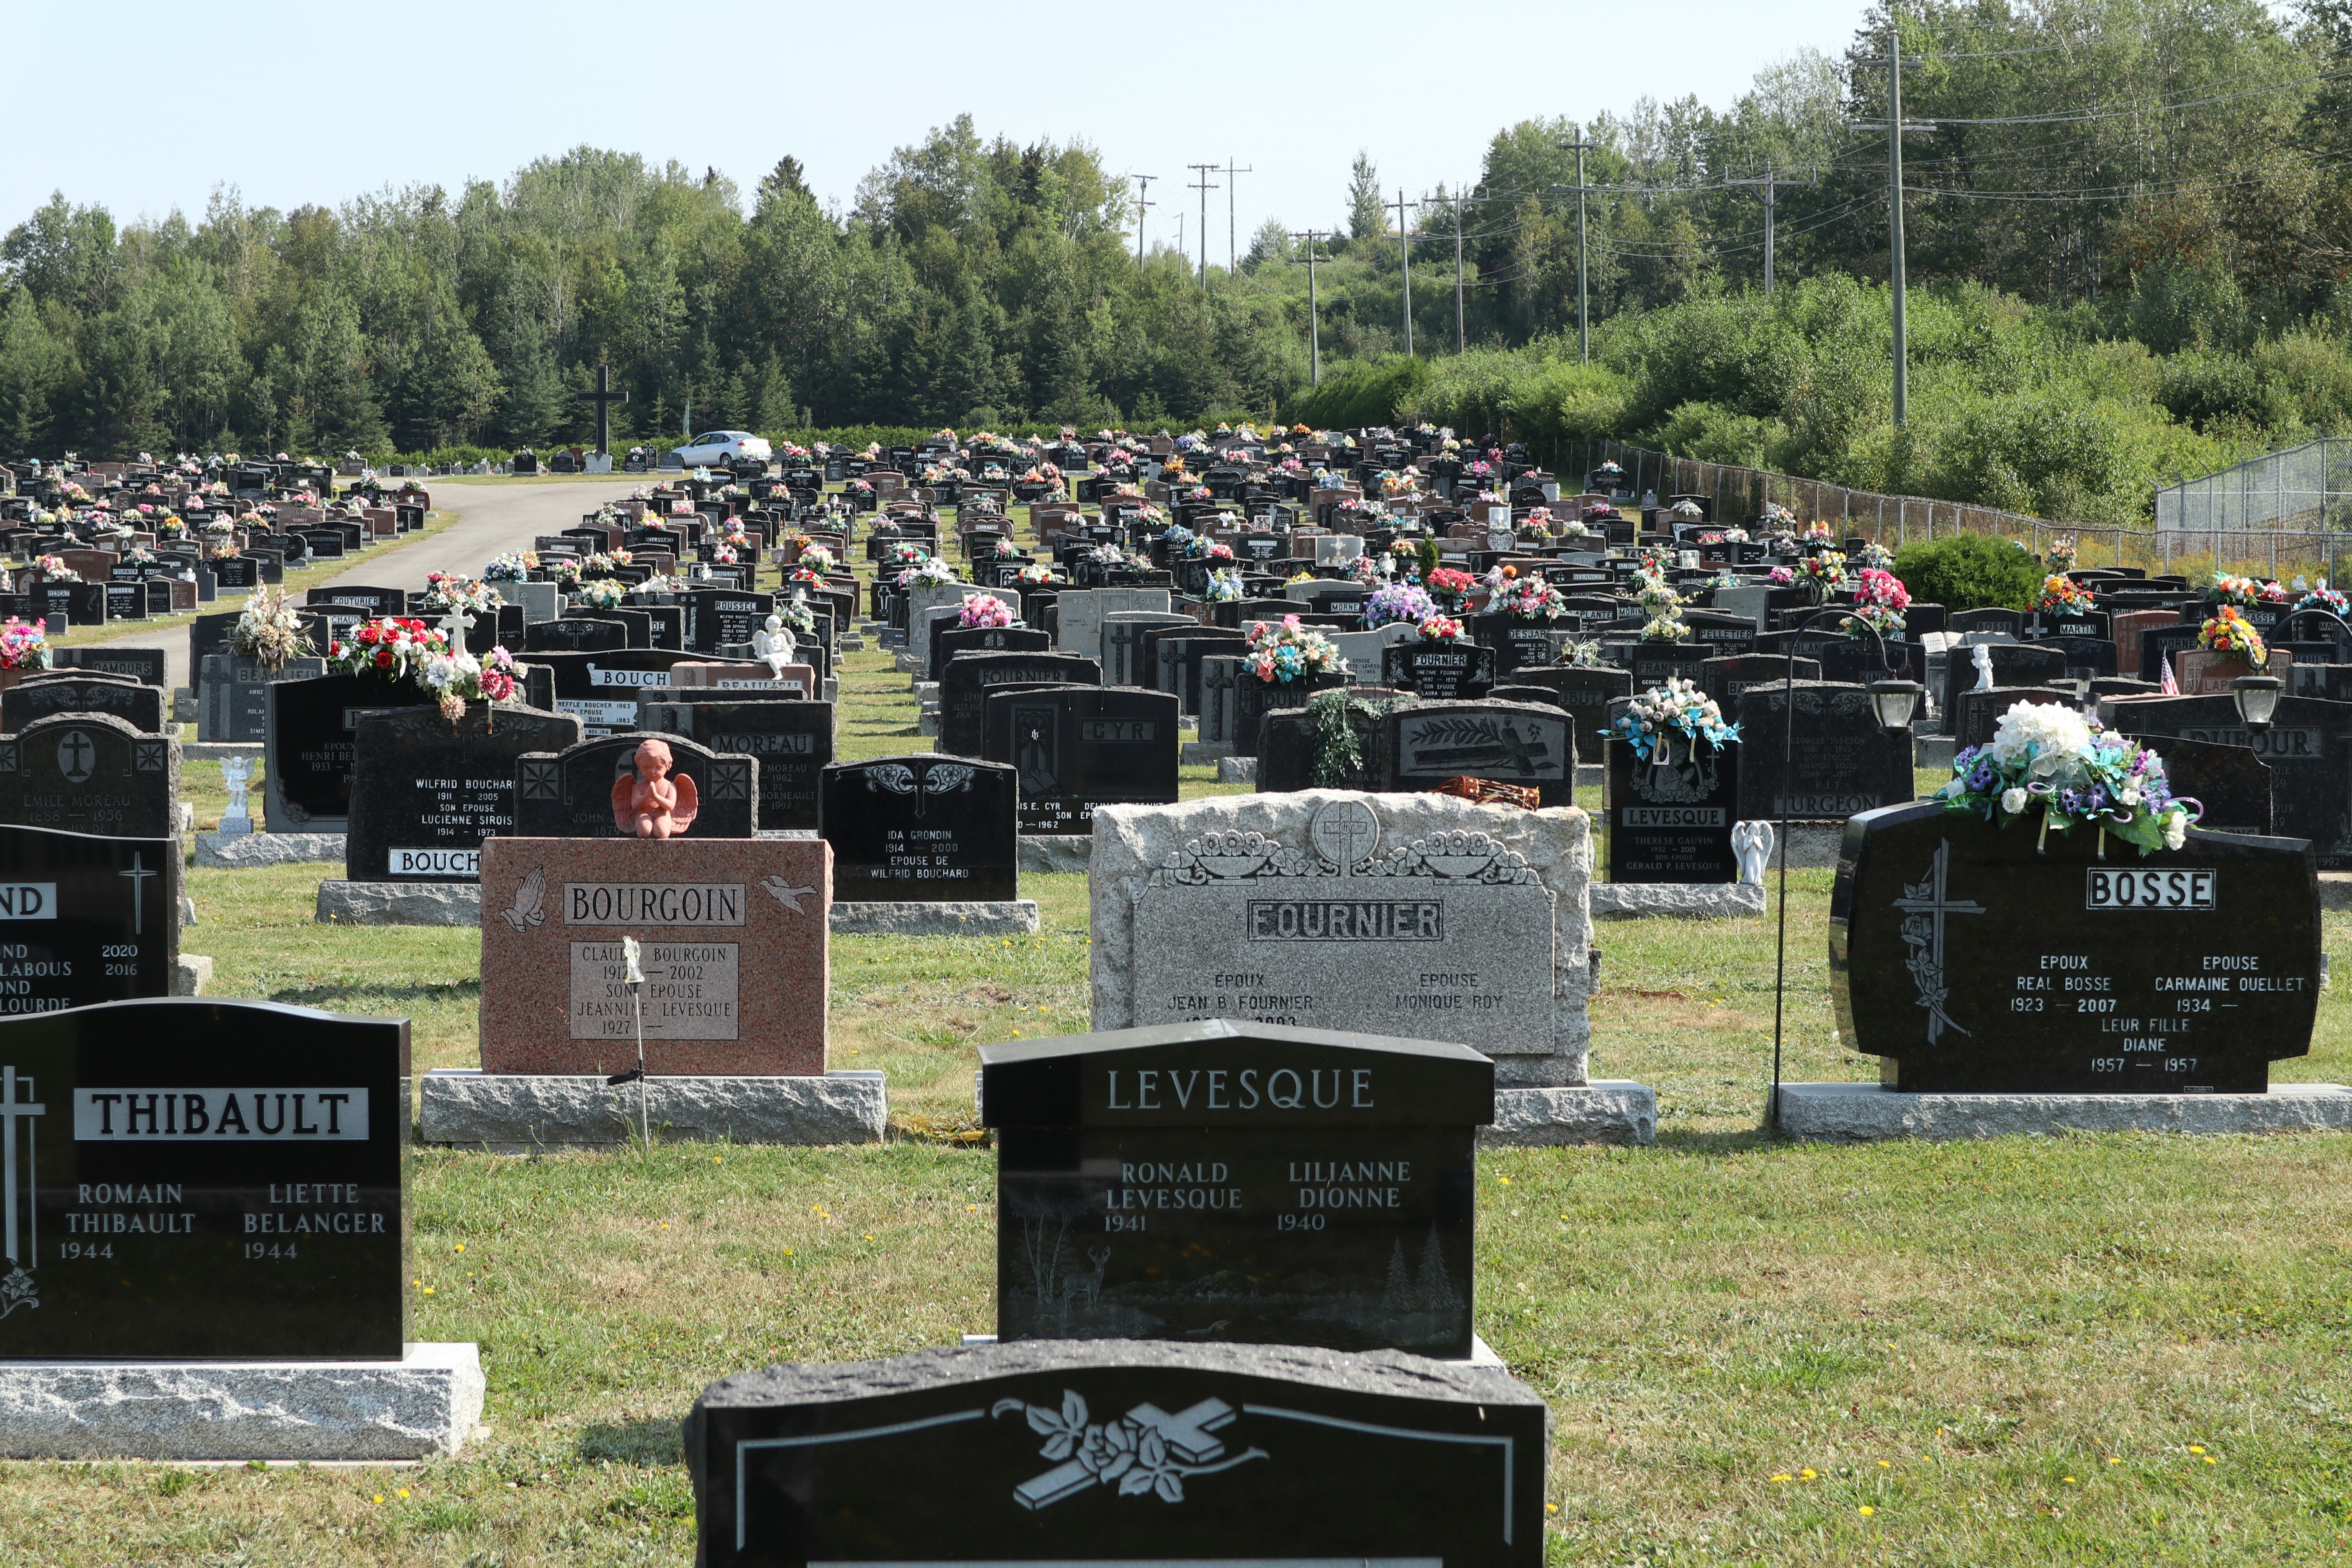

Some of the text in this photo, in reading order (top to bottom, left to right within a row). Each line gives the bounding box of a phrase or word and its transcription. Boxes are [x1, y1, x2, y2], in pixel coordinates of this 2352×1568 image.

[334, 597, 378, 606] COUTURIER
[716, 602, 756, 610] ROUSSEL
[1700, 630, 1752, 639] PELLETIER
[2061, 625, 2096, 634] MARTIN
[1414, 655, 1466, 665] FOURNIER
[94, 663, 151, 674] DAMOURS
[982, 671, 1062, 683] FOURNIER
[1093, 722, 1145, 740] CYR
[718, 735, 808, 753] MOREAU
[301, 752, 334, 761] HENRI
[312, 762, 330, 771] 1933
[768, 764, 807, 773] MOREAU
[416, 779, 457, 789] WILFRID
[772, 774, 793, 782] 1962
[24, 794, 131, 807] EMILE MOREAU
[437, 792, 499, 801] 1911 2005
[759, 791, 816, 800] MORNEAULT
[771, 802, 792, 810] 1997
[30, 810, 123, 822] 1888 1956
[422, 815, 512, 826] LUCIENNE SIROIS
[572, 813, 605, 823] JOHN
[1629, 809, 1720, 825] LEVESQUE
[93, 824, 106, 833] DE
[437, 828, 496, 837] 1914 1973
[888, 830, 952, 840] IDA GRONDIN
[885, 843, 958, 853] 1914 2000
[890, 856, 948, 866] EPOUSE DE
[871, 868, 969, 879] WILFRID BOUCHARD
[2092, 873, 2211, 906] BOSSE
[572, 887, 737, 922] BOURGOIN
[1254, 904, 1440, 938] FOURNIER
[102, 945, 138, 957] 2020
[654, 947, 727, 962] BOURGOIN
[105, 964, 137, 976] 2016
[2040, 956, 2088, 970] EPOUX
[2203, 956, 2259, 970] EPOUSE
[670, 965, 703, 980] 2002
[1214, 974, 1265, 988] EPOUX
[1420, 974, 1478, 988] EPOUSE
[2017, 976, 2112, 991] REAL BOSSE
[2155, 977, 2305, 991] CARMAINE OUELLET
[606, 984, 702, 998] SON EPOUSE
[578, 1002, 731, 1017] JEANNINE LEVESQUE
[1167, 996, 1313, 1011] JEAN FOURNIER
[1395, 995, 1503, 1010] MONIQUE ROY
[2011, 998, 2116, 1013] 1923 2007
[2177, 998, 2211, 1012] 1934
[603, 1020, 631, 1034] 1927
[2102, 1018, 2190, 1032] LEUR FILLE
[2123, 1038, 2167, 1052] DIANE
[2091, 1058, 2198, 1073] 1957 1957
[1107, 1068, 1374, 1109] LEVESQUE
[92, 1093, 349, 1134] THIBAULT
[1122, 1162, 1229, 1183] RONALD
[1289, 1161, 1412, 1182] LILIANNE
[79, 1183, 182, 1204] ROMAIN
[269, 1183, 360, 1203] LIETTE
[1107, 1189, 1243, 1210] LEVESQUE
[1299, 1187, 1401, 1209] DIONNE
[66, 1213, 196, 1234] THIBAULT
[244, 1213, 386, 1234] BELANGER
[1105, 1214, 1147, 1232] 1941
[1277, 1214, 1325, 1231] 1940
[61, 1242, 114, 1259] 1944
[245, 1242, 298, 1259] 1944
